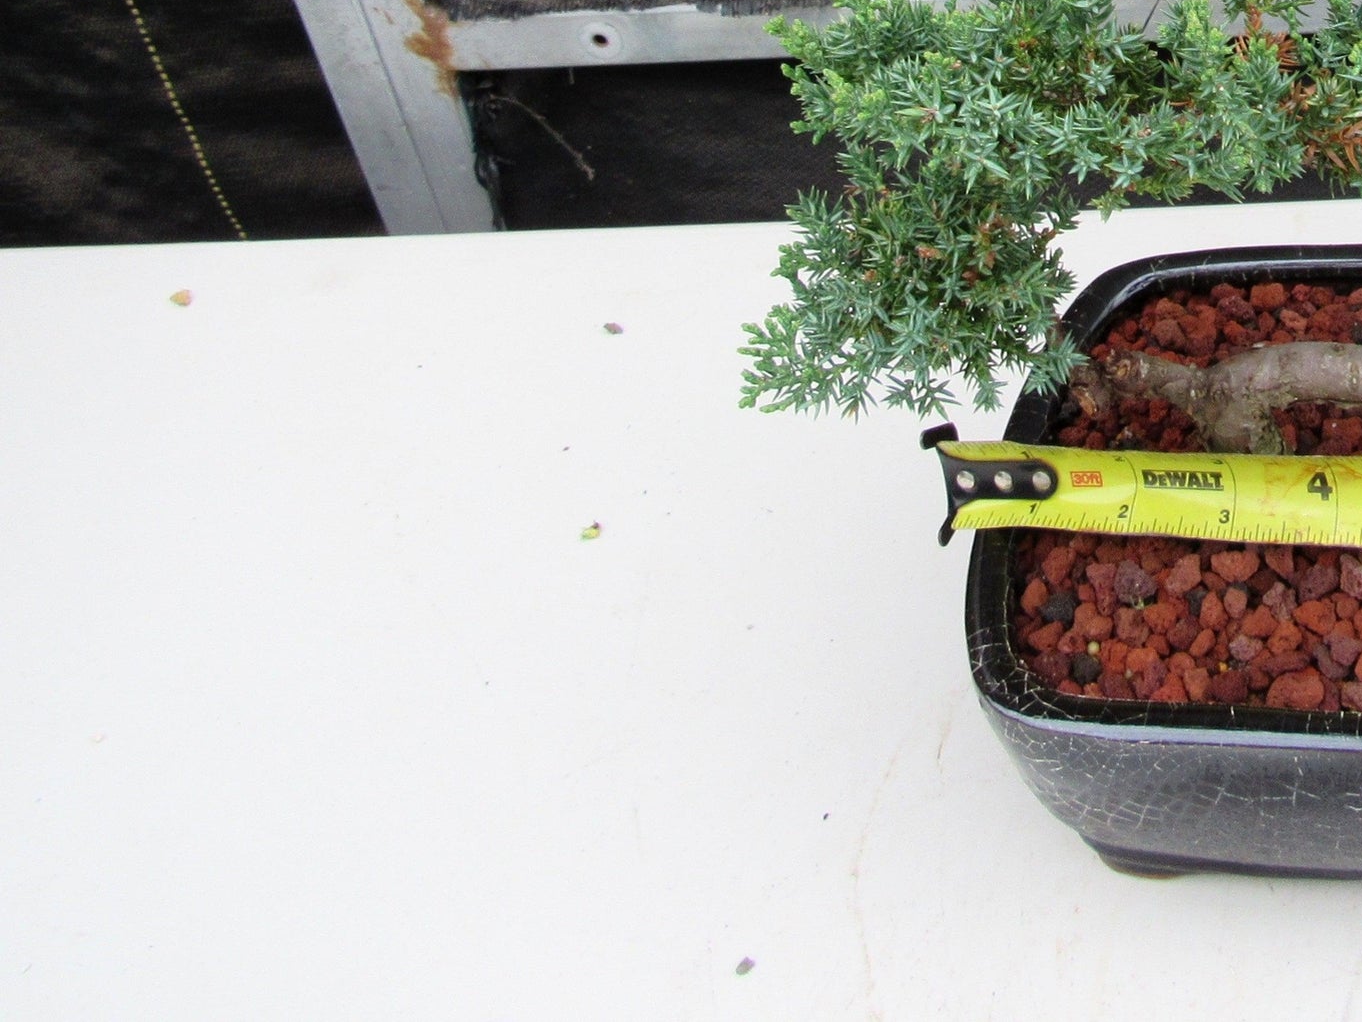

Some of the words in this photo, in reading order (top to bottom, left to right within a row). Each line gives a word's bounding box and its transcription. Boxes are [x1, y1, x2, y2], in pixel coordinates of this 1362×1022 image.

[1307, 472, 1332, 501] 4
[1029, 502, 1037, 515] 1
[1117, 504, 1129, 519] 2
[1218, 509, 1230, 524] 3
